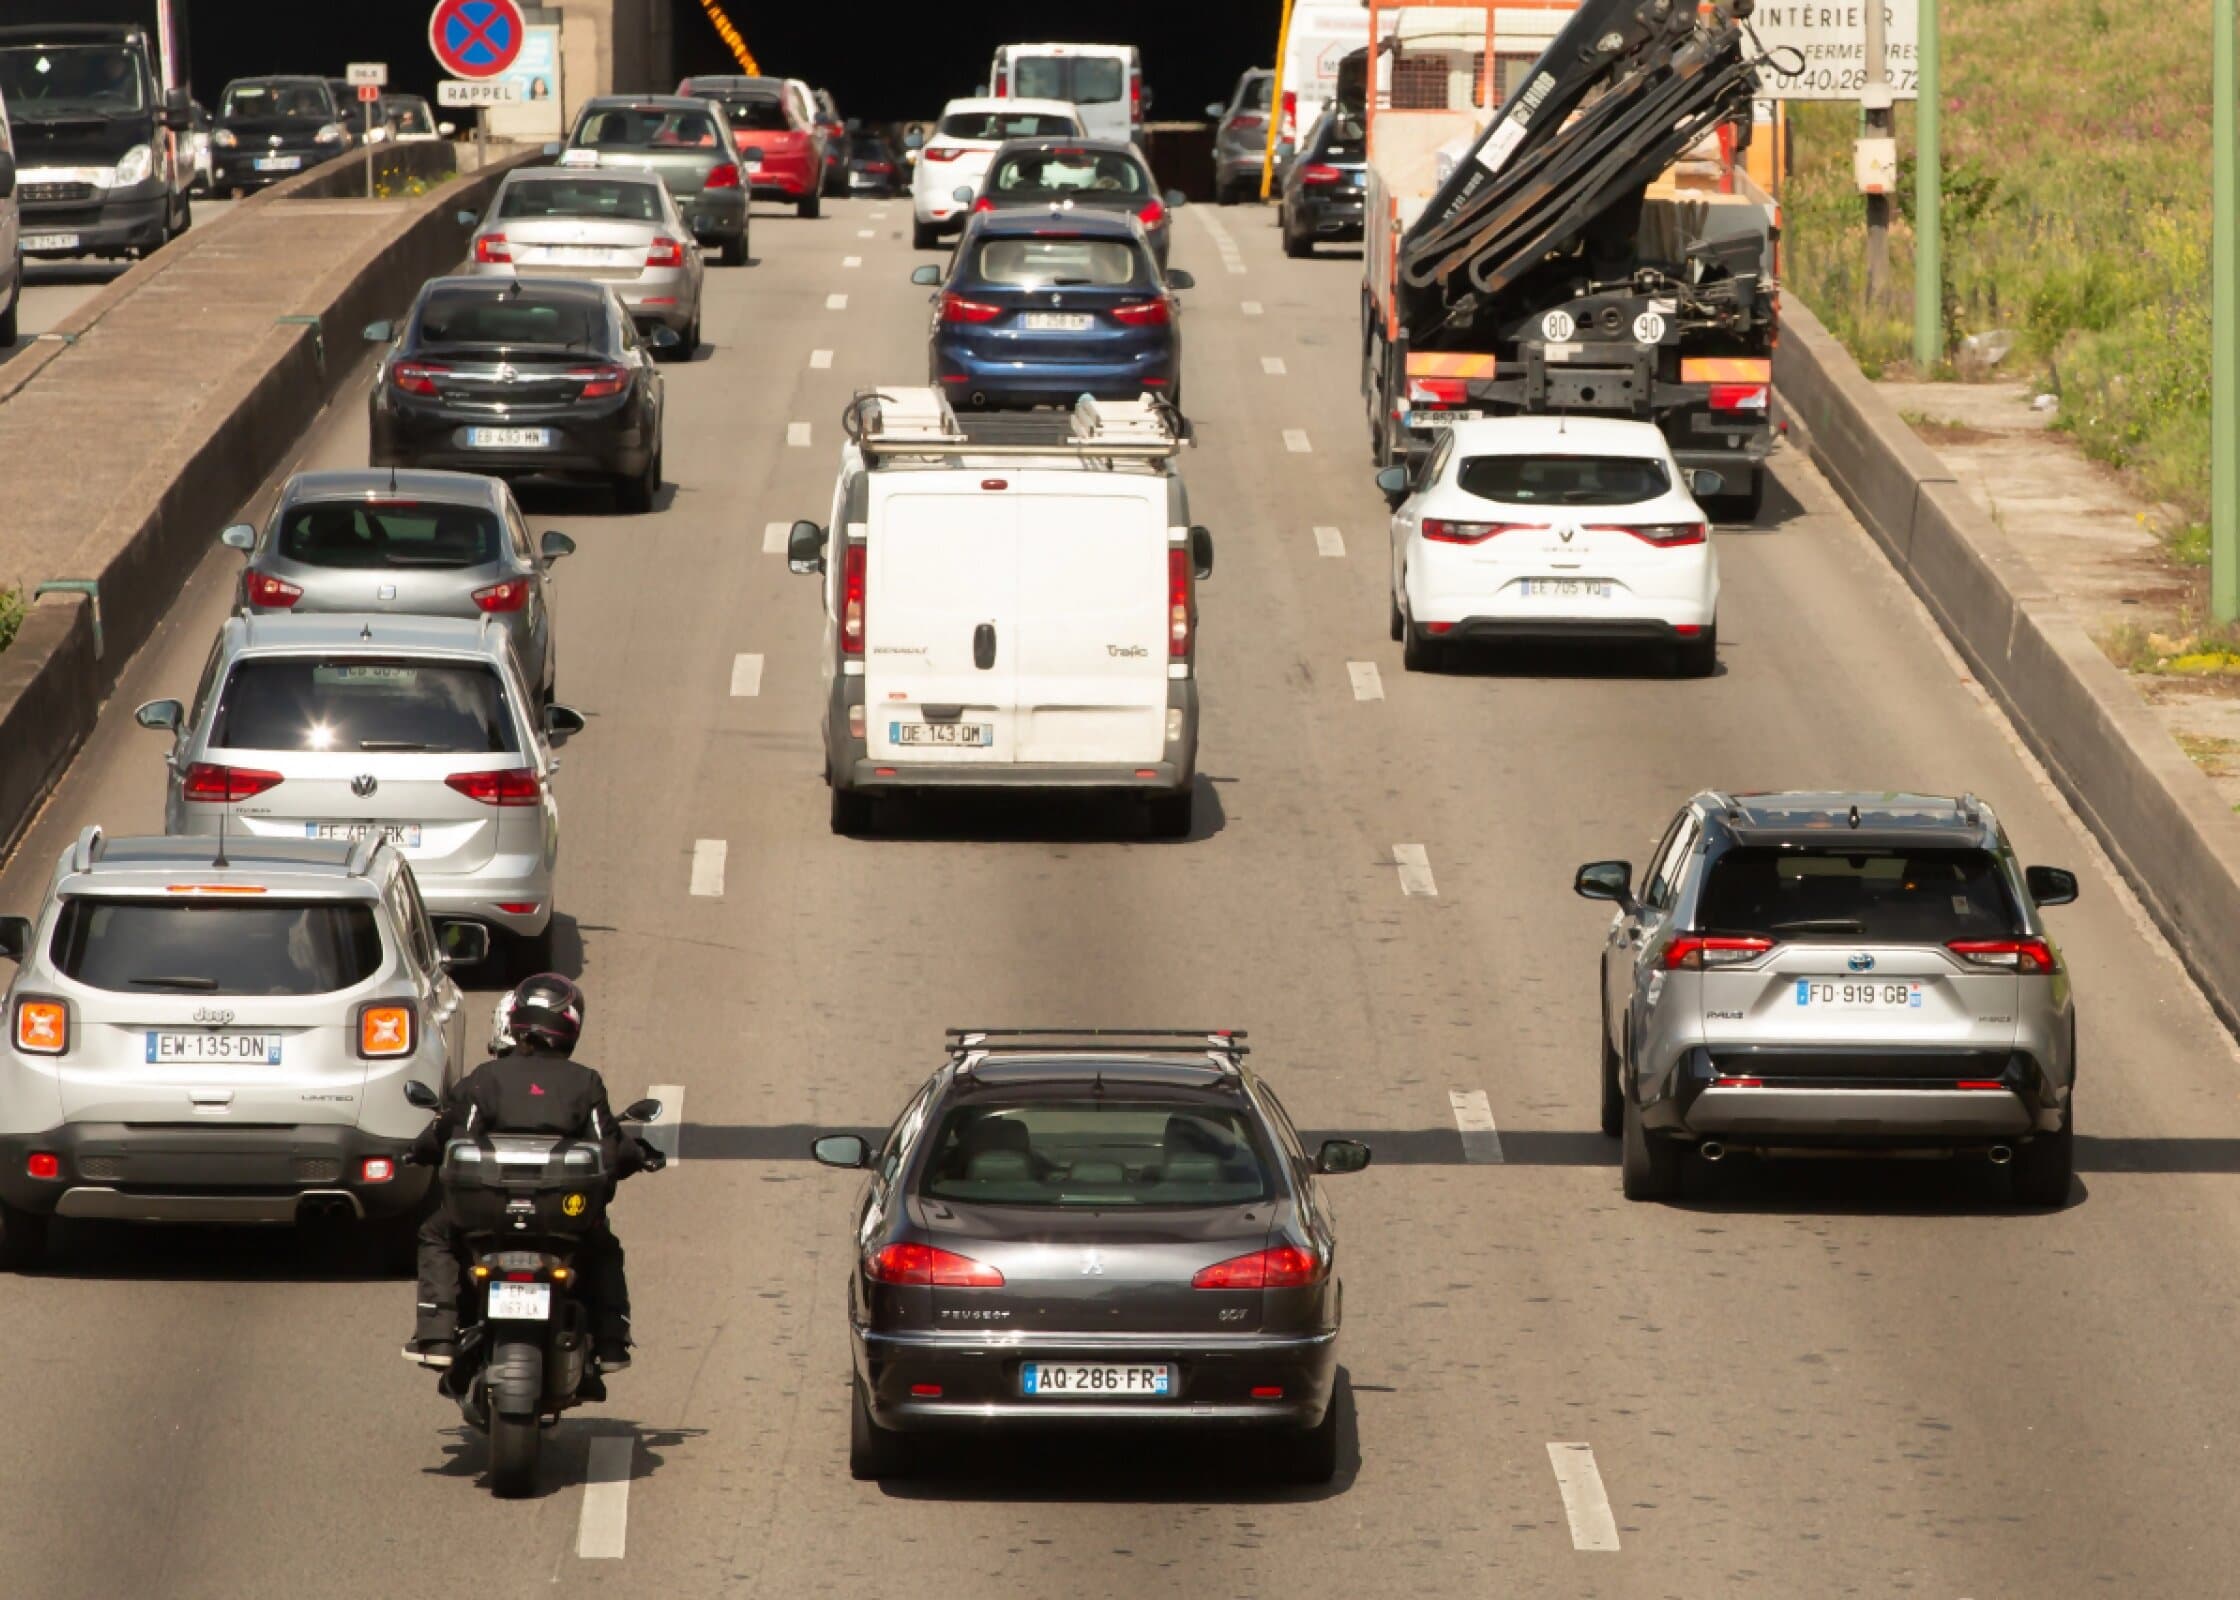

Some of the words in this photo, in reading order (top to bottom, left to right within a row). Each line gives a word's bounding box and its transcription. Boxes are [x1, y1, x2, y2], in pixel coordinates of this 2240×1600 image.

[1760, 4, 1894, 28] INTÉRIER
[1804, 44, 1919, 59] FERMERES
[448, 87, 512, 100] RAPPEL
[1549, 314, 1568, 338] 80
[1639, 316, 1659, 339] 90
